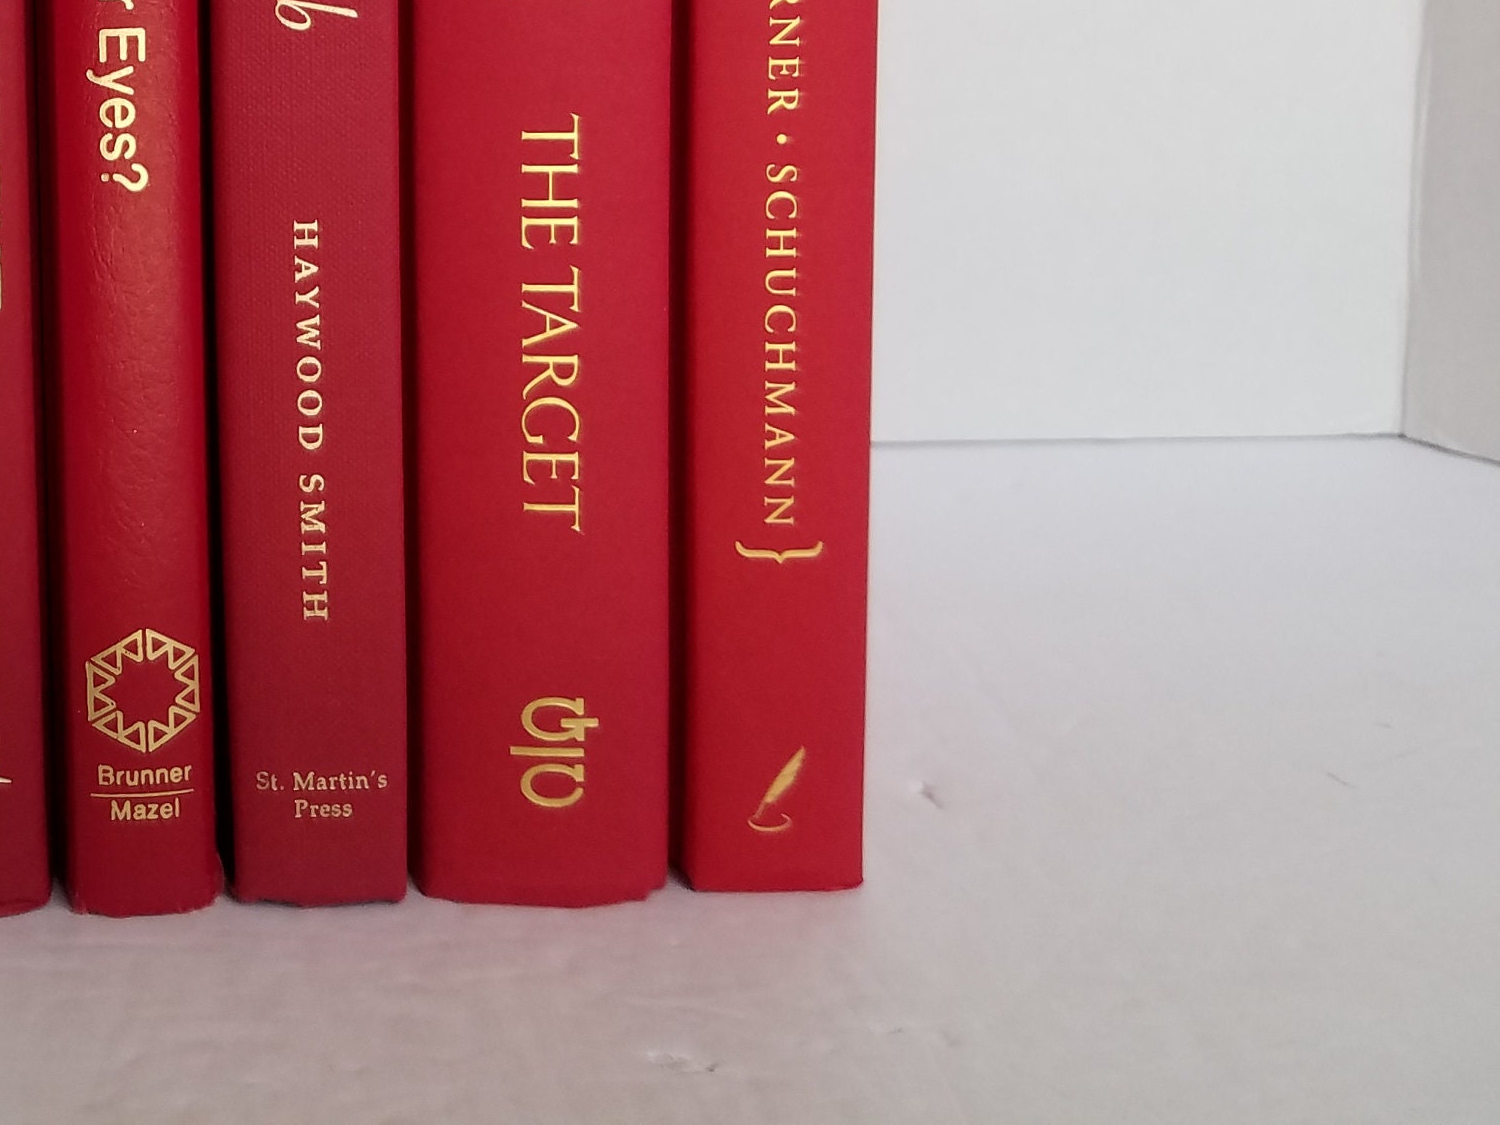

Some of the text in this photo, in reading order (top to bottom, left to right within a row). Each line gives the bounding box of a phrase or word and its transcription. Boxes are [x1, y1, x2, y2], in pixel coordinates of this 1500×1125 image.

[85, 26, 151, 193] Eyes?
[520, 112, 581, 533] THE TARGET
[293, 219, 329, 621] HAYWOOD SMITH
[97, 764, 193, 787] Brunner
[256, 770, 388, 792] St. Martin's
[111, 797, 180, 821] Mazel
[294, 799, 353, 818] Press
